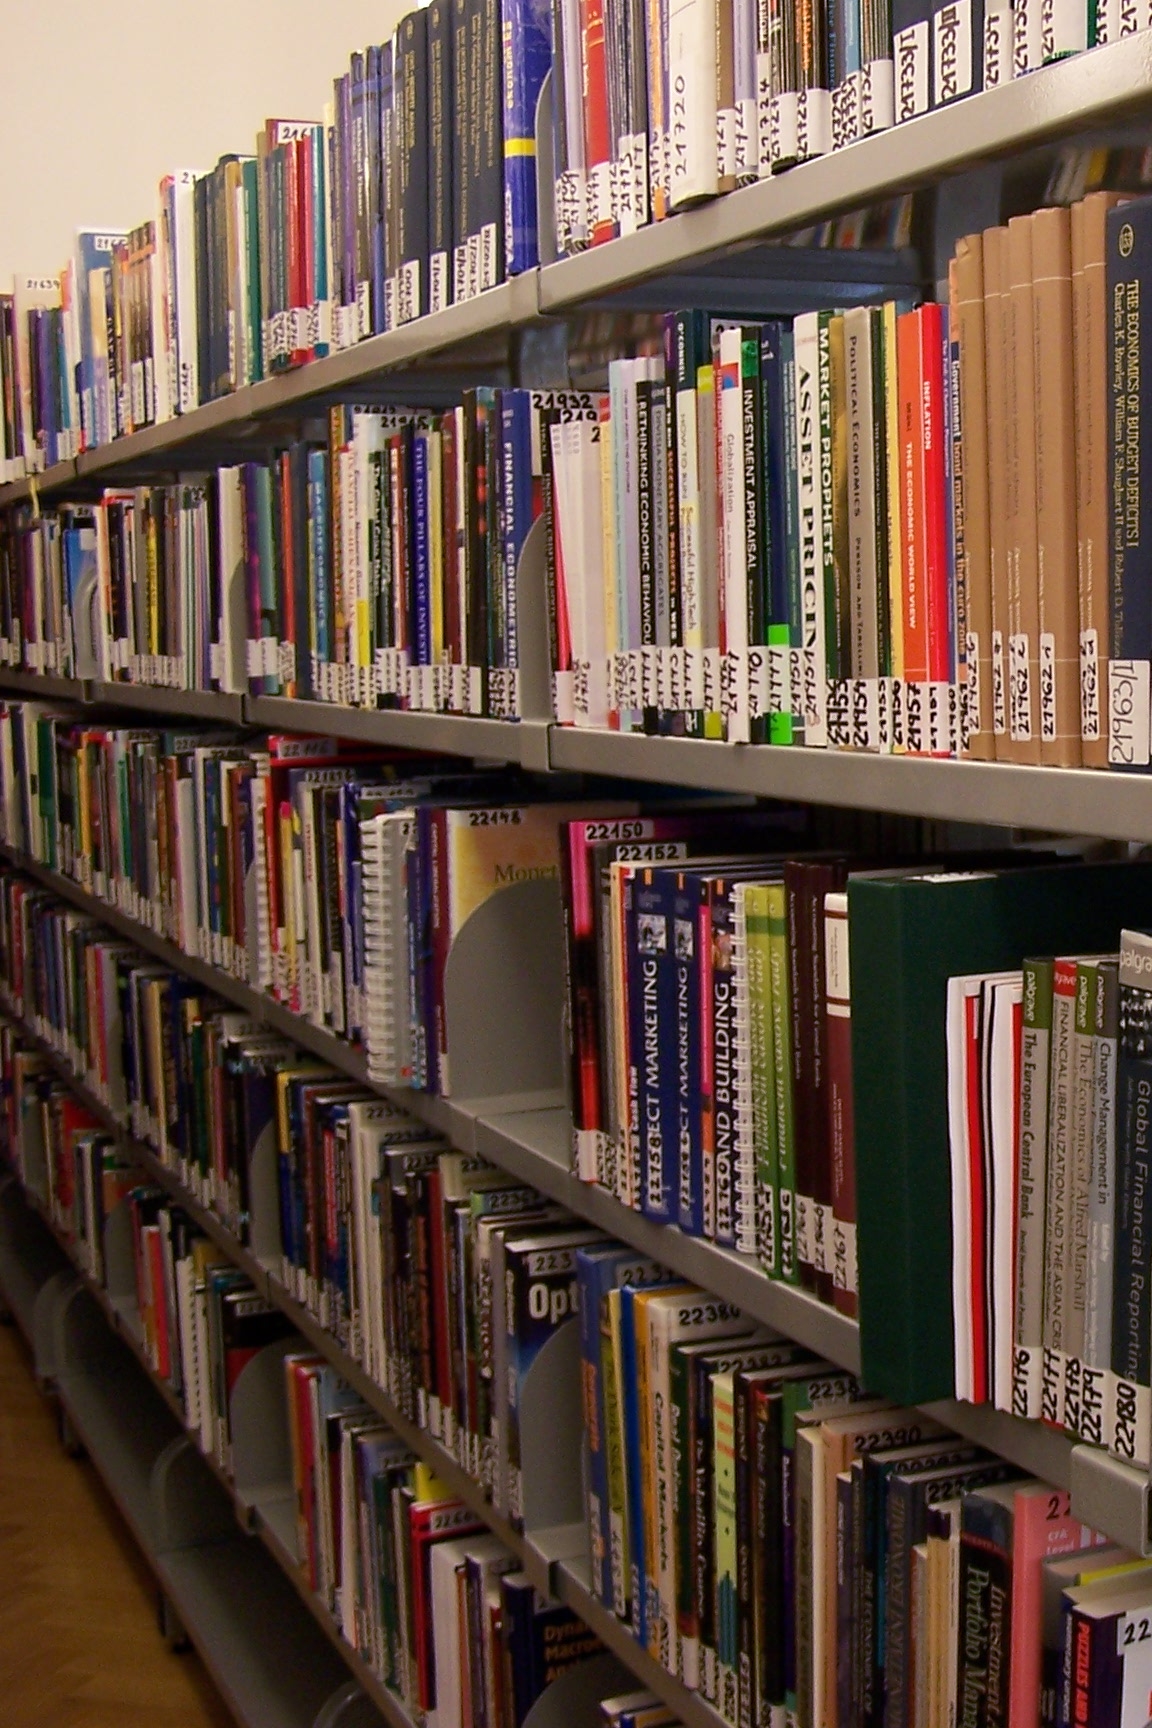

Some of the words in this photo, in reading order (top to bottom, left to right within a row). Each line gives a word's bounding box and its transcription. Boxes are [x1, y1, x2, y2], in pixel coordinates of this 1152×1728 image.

[674, 75, 686, 176] 21720
[1126, 280, 1139, 310] THE
[819, 328, 830, 429] MARKET
[1126, 312, 1139, 392] ECONOMICS
[532, 393, 593, 410] 21932
[799, 365, 814, 494] ASSET
[924, 381, 932, 450] INFLATION
[951, 360, 962, 438] Government
[1126, 394, 1139, 412] OF
[637, 401, 649, 489] RETHINKING
[726, 433, 736, 514] Globalization
[744, 389, 754, 486] INVESTMENT
[906, 442, 915, 467] THE
[1126, 416, 1139, 474] BUDGET
[504, 441, 515, 536] FINANCIAL
[821, 437, 833, 567] PROPHETS
[906, 470, 915, 541] ECONOMIC
[1126, 477, 1139, 539] DEFICITS
[640, 492, 651, 572] ECONOMIC
[746, 490, 756, 571] APPRAISAL
[802, 508, 817, 648] PRICIN
[907, 545, 916, 592] WORLD
[506, 542, 518, 668] ECONOMETRIC
[642, 575, 651, 645] BEHAVIOU
[908, 595, 916, 629] VIEW
[1017, 667, 1029, 734] 21962
[1042, 664, 1053, 736] 21962
[1111, 660, 1138, 763] 21963/I
[643, 961, 661, 1090] MARKETING
[1026, 970, 1038, 1022] palgrave
[1077, 975, 1088, 1028] palgrave
[678, 967, 689, 1098] MARKETING
[715, 982, 731, 1105] BUILDING
[1025, 1033, 1037, 1057] The
[1059, 1001, 1070, 1079] FINANCIAL
[1080, 1041, 1092, 1073] The
[1098, 1042, 1111, 1094] Change
[1022, 1062, 1037, 1127] European
[1078, 1078, 1091, 1164] Economics
[1135, 1080, 1151, 1153] Global
[1022, 1131, 1035, 1180] Central
[1055, 1083, 1067, 1201] LIBERALIZATION
[1077, 1167, 1089, 1182] of
[1096, 1098, 1111, 1187] Management
[1021, 1184, 1034, 1218] Bank
[1054, 1203, 1065, 1238] AND
[1075, 1187, 1088, 1238] Alfred
[1098, 1190, 1109, 1204] in
[1131, 1161, 1148, 1265] Financial
[1054, 1242, 1064, 1268] THE
[1074, 1242, 1086, 1311] Marshall
[1053, 1273, 1063, 1316] ASIAN
[1126, 1273, 1145, 1385] Reporting
[1013, 1350, 1029, 1417] 22176
[1042, 1349, 1060, 1422] 22177
[1081, 1369, 1102, 1444] 22179
[1115, 1382, 1135, 1459] 22180
[966, 1566, 989, 1659] Portfolio
[988, 1584, 1006, 1713] Investment
[1076, 1621, 1091, 1687] PUZZLES
[1076, 1689, 1091, 1723] AND
